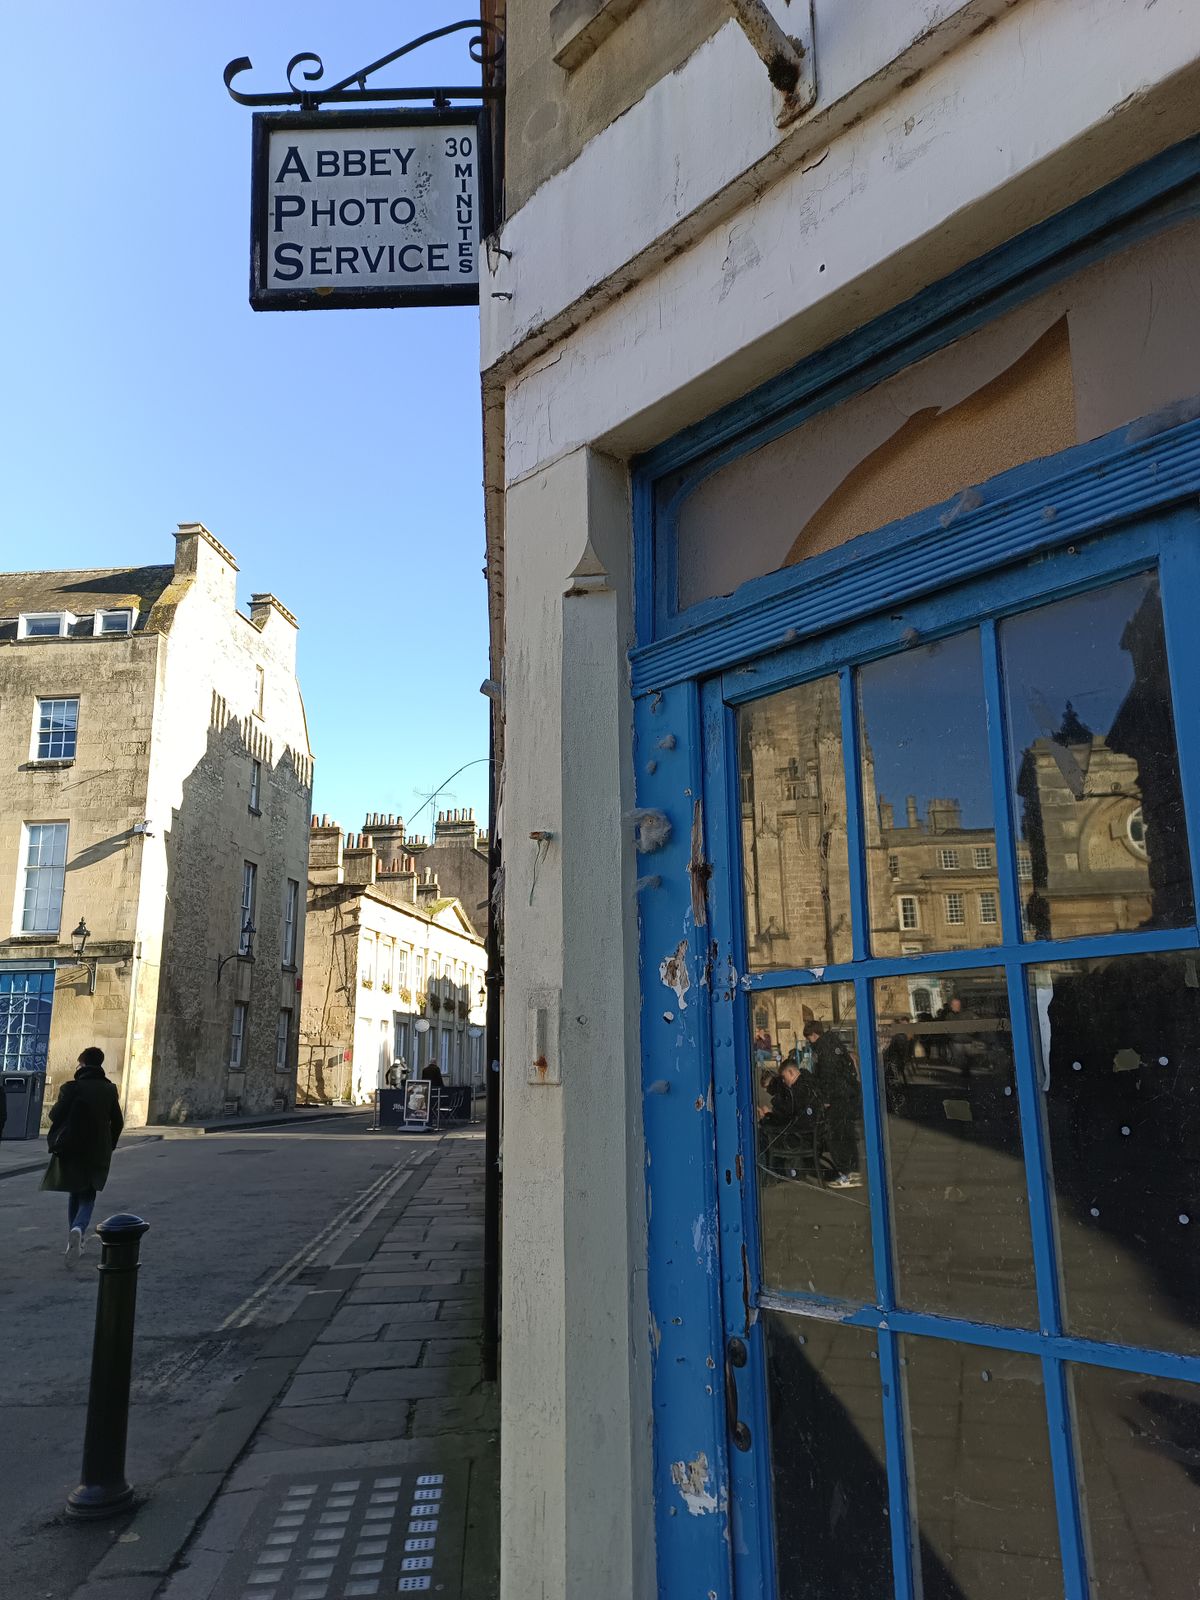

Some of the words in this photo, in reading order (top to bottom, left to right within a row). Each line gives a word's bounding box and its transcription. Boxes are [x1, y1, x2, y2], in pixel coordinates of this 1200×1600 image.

[274, 146, 416, 183] ABBEY
[444, 136, 473, 158] 30
[273, 195, 416, 232] PHOTO
[454, 163, 473, 274] MINUTES
[273, 242, 450, 281] SERVICE
